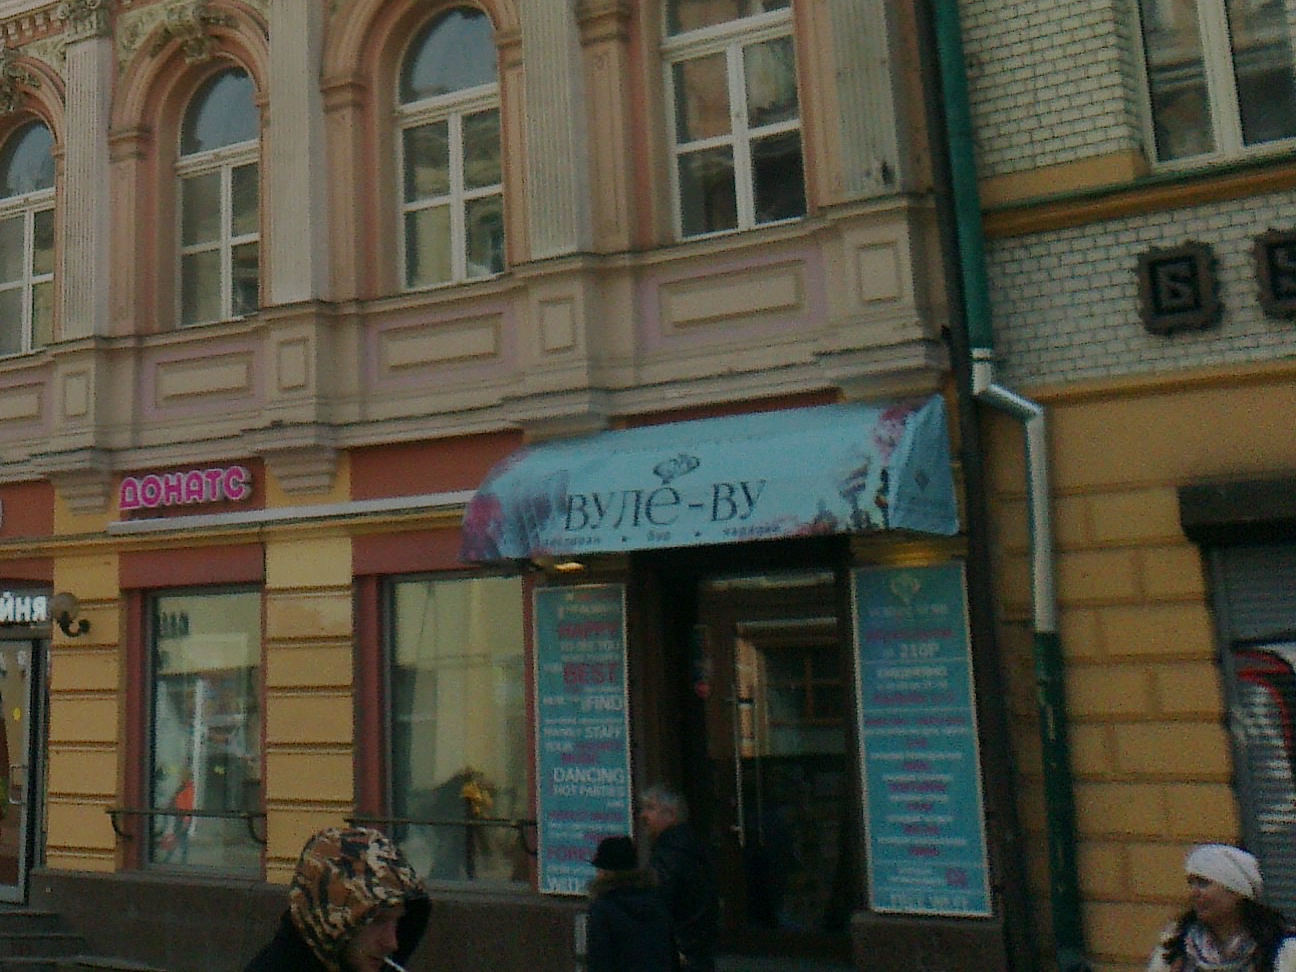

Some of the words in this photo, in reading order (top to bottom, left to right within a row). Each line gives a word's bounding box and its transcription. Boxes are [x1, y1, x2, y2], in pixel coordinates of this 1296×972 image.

[119, 466, 246, 509] ДОНАТС
[564, 663, 619, 685] BEST
[553, 768, 625, 783] DANCING
